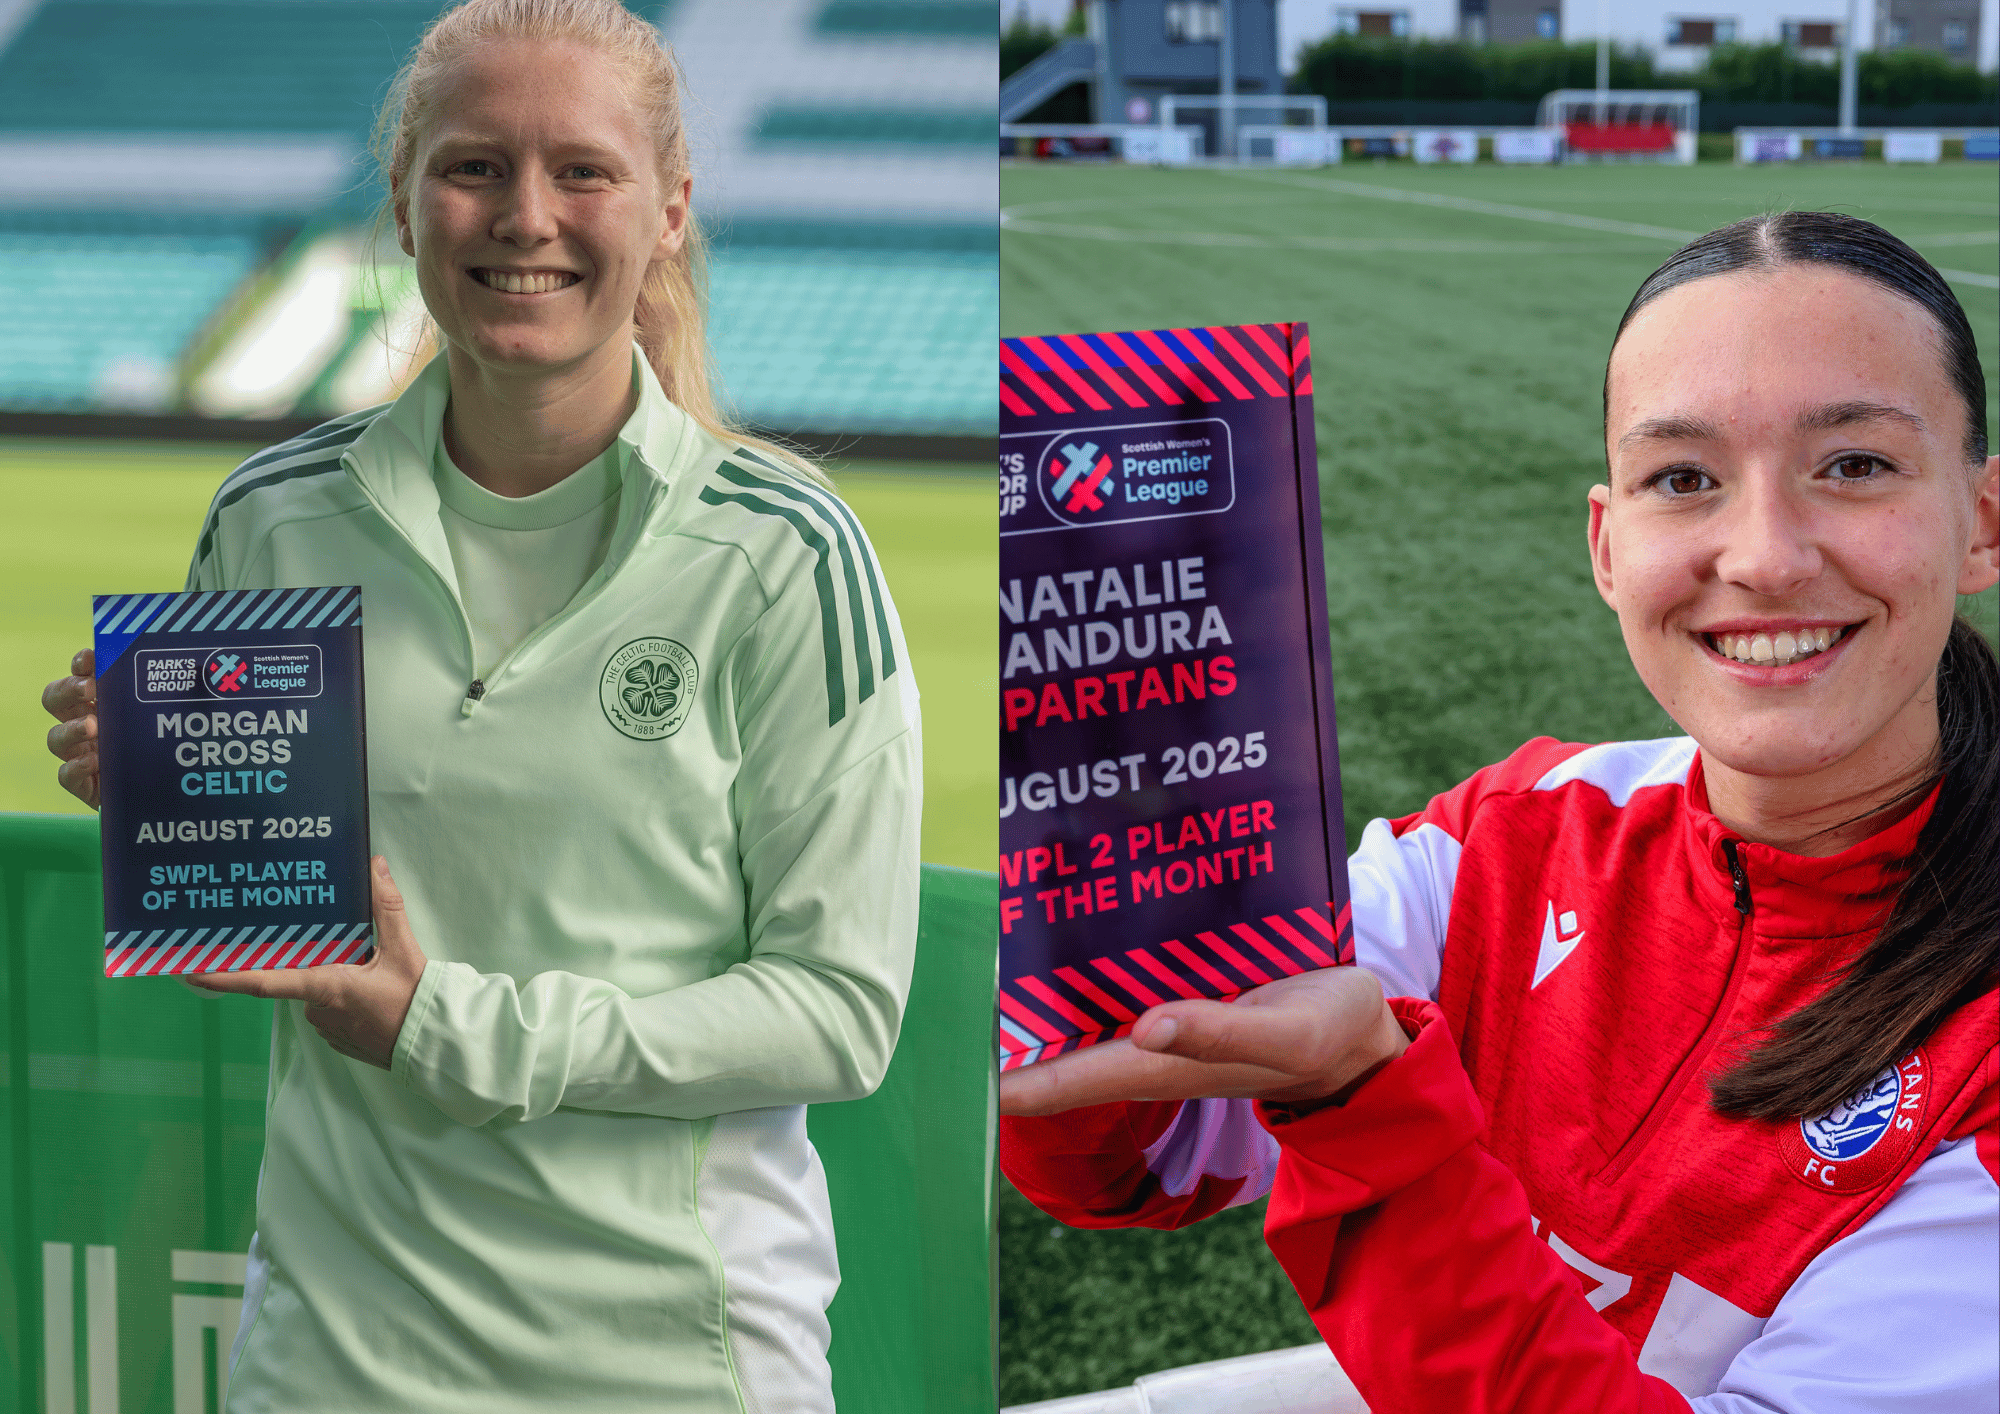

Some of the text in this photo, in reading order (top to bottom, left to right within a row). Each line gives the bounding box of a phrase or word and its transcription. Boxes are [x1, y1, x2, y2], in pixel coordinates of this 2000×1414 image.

[1122, 437, 1211, 454] Scottish Women's
[1122, 450, 1212, 478] Premier
[1124, 479, 1209, 505] League
[1000, 556, 1207, 624] NATALIE
[1000, 605, 1233, 679] ANDURA
[147, 658, 197, 671] PARK'S
[253, 661, 310, 675] Premier
[281, 654, 310, 662] Women's
[606, 642, 695, 695] THE CELTIC FOOTBALL CLUB
[147, 669, 197, 681] MOTOR
[147, 681, 196, 692] GROUP
[254, 677, 307, 691] League
[1000, 655, 1238, 732] PARTANS
[156, 709, 308, 738] MORGAN
[633, 724, 655, 735] 1888
[175, 739, 292, 767] CROSS
[1161, 731, 1268, 785] 2025
[180, 769, 288, 796] CELTIC
[136, 816, 332, 843] AUGUST 2025
[1089, 833, 1115, 869] 2
[1127, 800, 1277, 860] PLAYER
[150, 860, 327, 886] SWPL PLAYER
[1036, 876, 1119, 924] THE
[1131, 841, 1274, 904] MONTH
[142, 885, 335, 910] OF THE MONTH
[1896, 1048, 1922, 1132] TANS
[1803, 1157, 1836, 1187] FC
